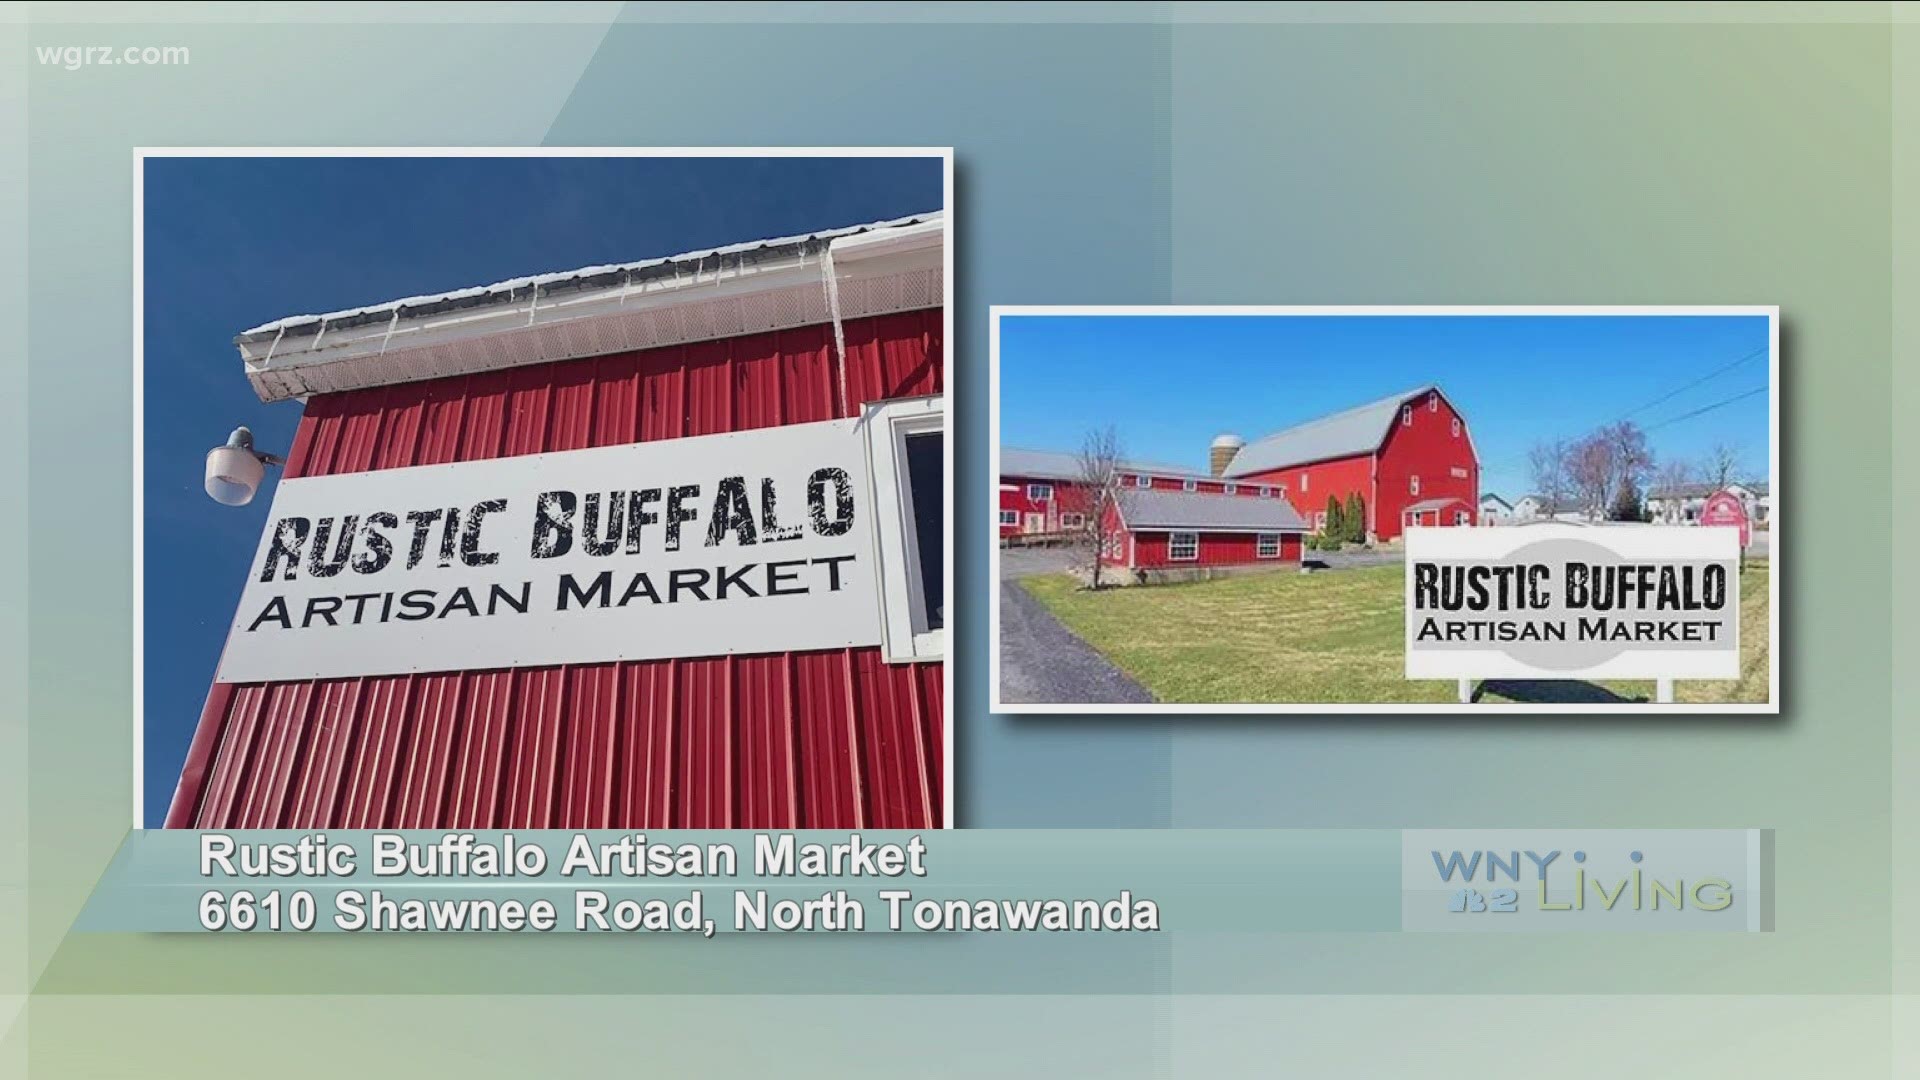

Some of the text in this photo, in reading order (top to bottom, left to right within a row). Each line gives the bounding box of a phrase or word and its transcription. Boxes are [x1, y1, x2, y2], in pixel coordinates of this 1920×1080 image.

[259, 466, 856, 582] RUSTIC BUFFALO
[247, 554, 857, 632] ARTISAN MARKET
[1414, 562, 1726, 612] RUSTIC BUFFALO
[1416, 617, 1723, 642] ARTISAN MARKET
